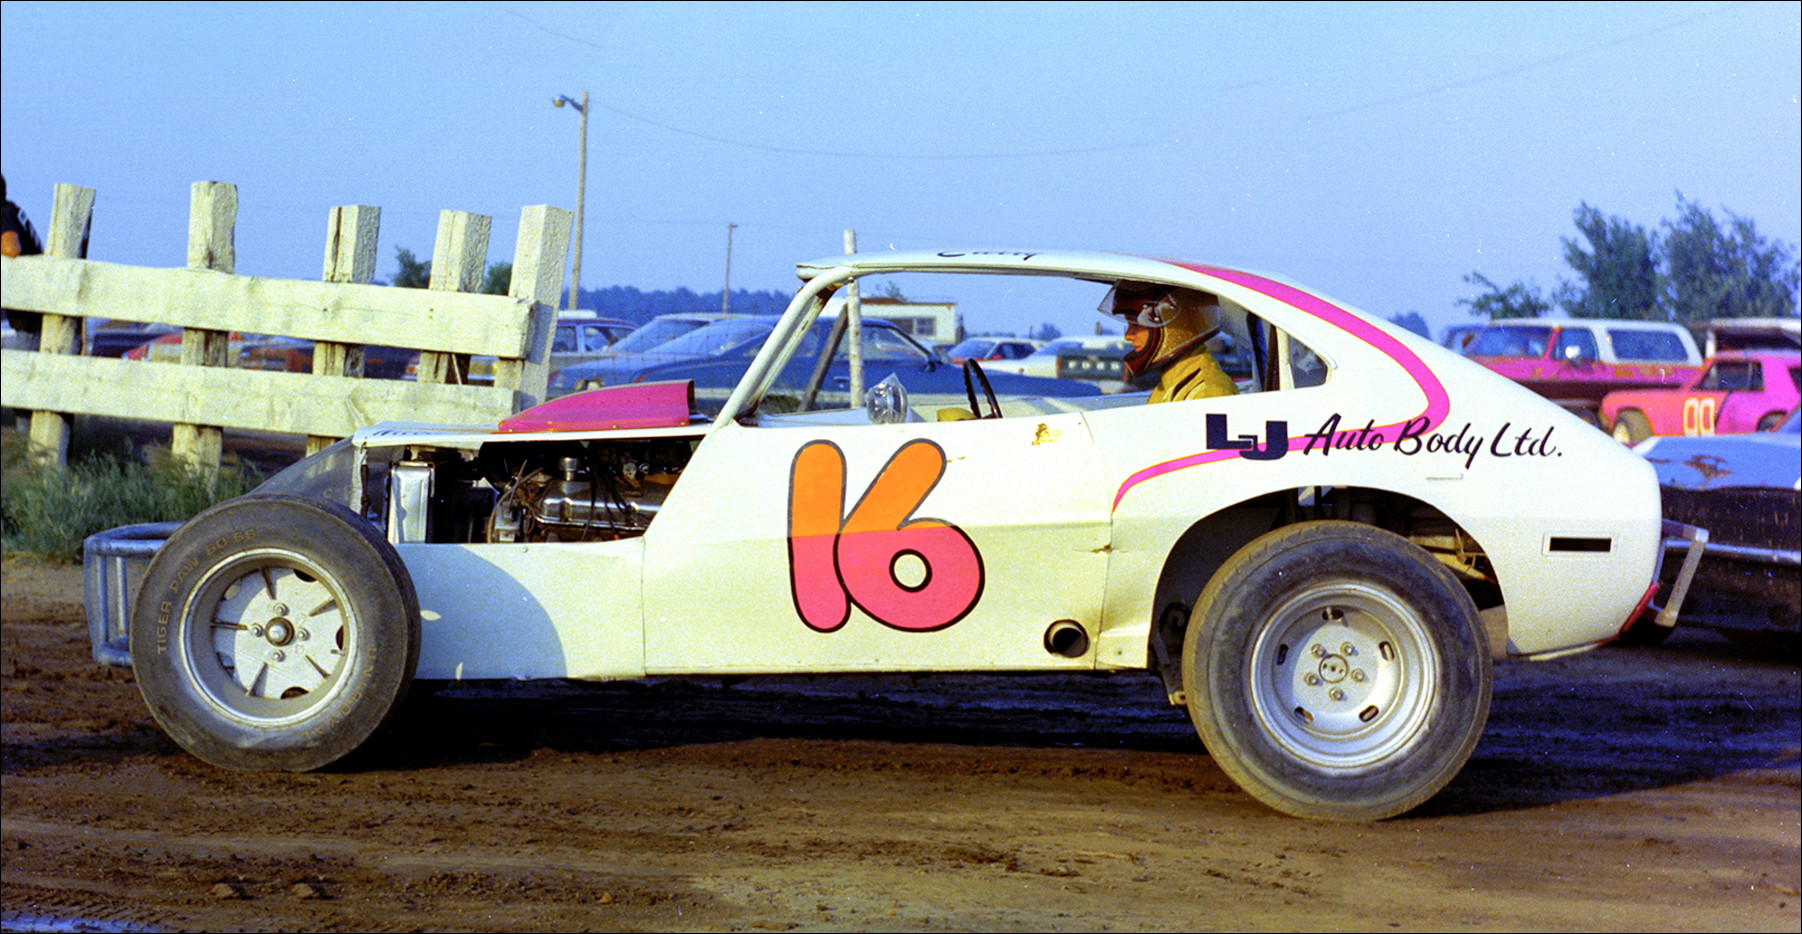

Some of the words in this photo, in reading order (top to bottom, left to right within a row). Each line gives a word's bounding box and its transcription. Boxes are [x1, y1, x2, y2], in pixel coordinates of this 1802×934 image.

[1067, 360, 1121, 371] FORD
[1205, 413, 1289, 461] LJ
[1303, 413, 1385, 457] Auto
[1393, 415, 1484, 470] Body
[1490, 422, 1563, 458] Ltd.
[787, 438, 986, 633] 16
[155, 600, 172, 655] TIGER
[170, 557, 199, 593] PAW
[300, 646, 377, 741] UNIROYAL
